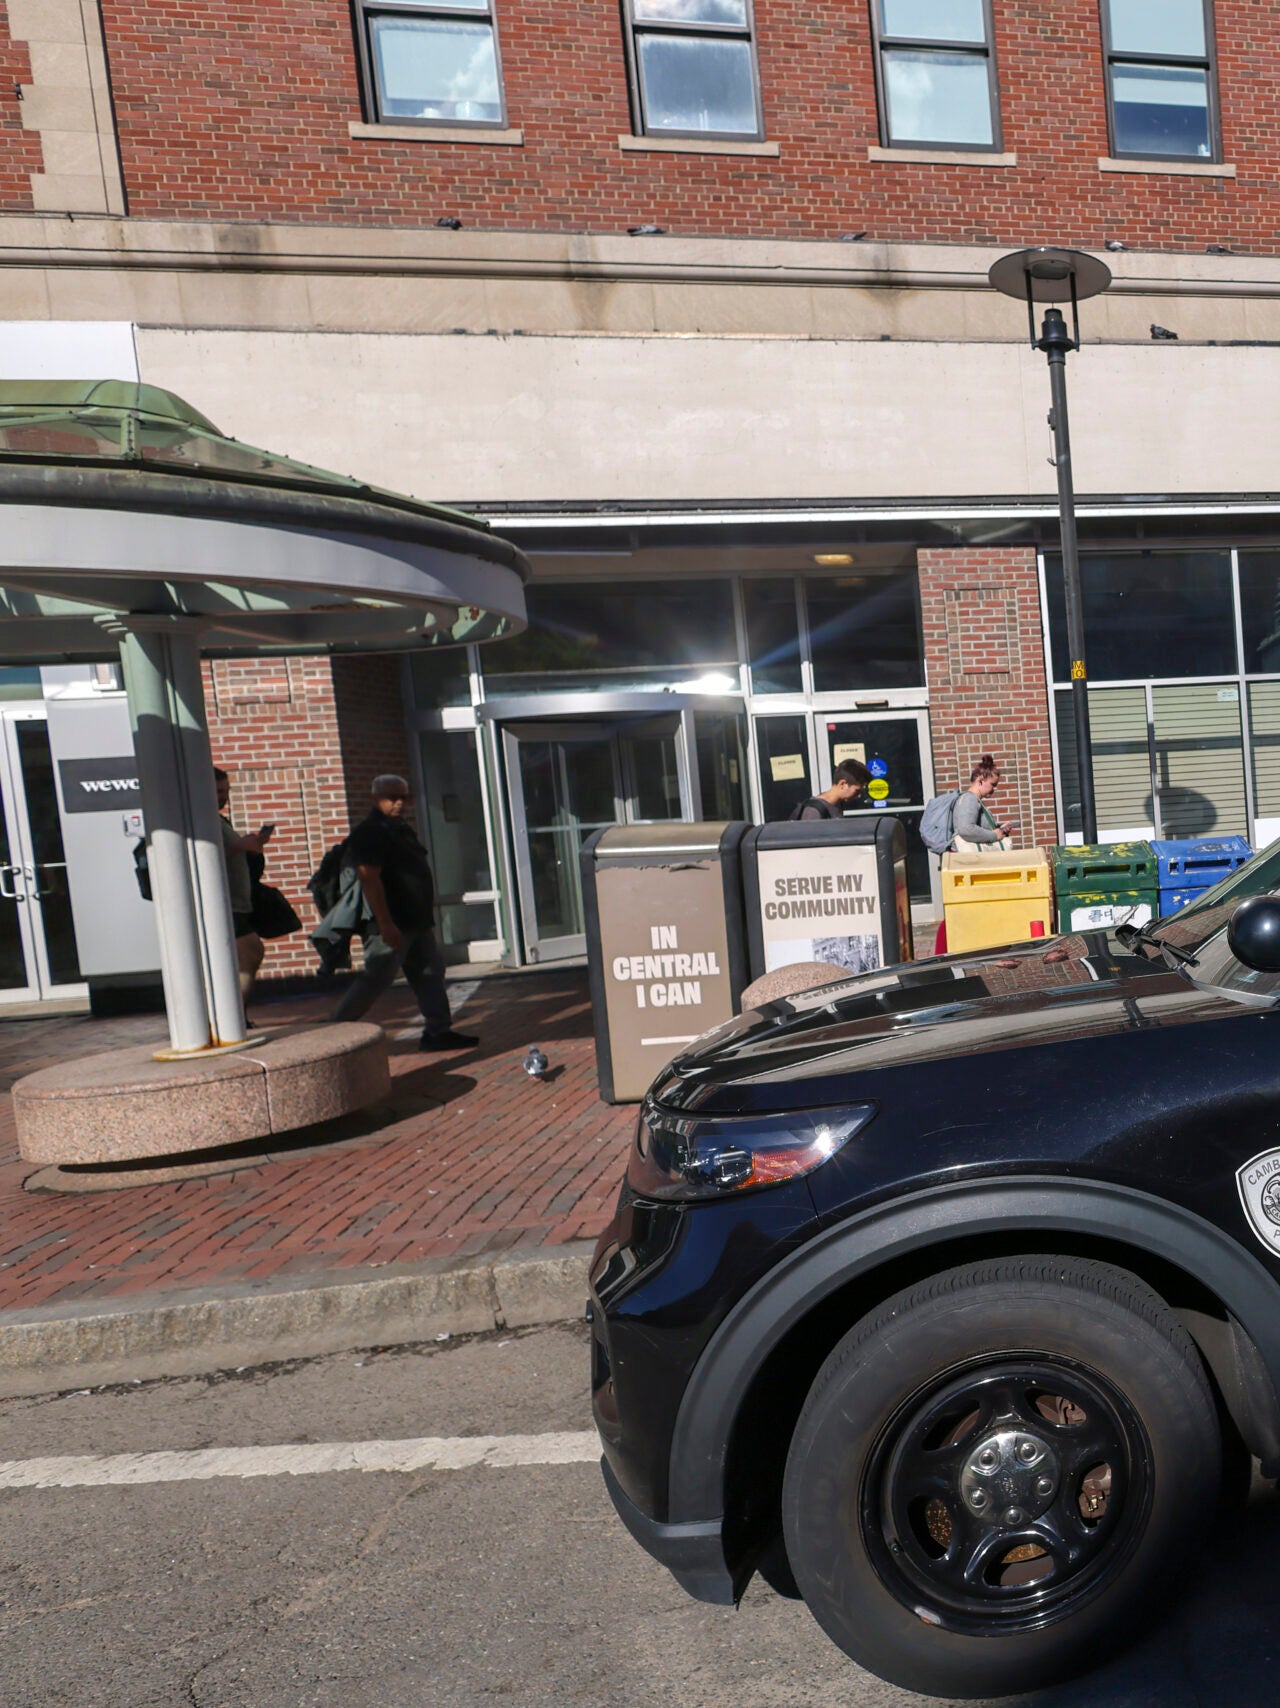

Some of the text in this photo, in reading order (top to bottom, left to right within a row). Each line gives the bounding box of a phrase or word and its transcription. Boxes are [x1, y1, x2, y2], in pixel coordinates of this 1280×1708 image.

[774, 874, 864, 897] SERVE MY
[764, 896, 876, 921] COMMUNITY
[650, 925, 678, 951] IN
[613, 951, 720, 981] CENTRAL
[635, 981, 702, 1009] I CAN
